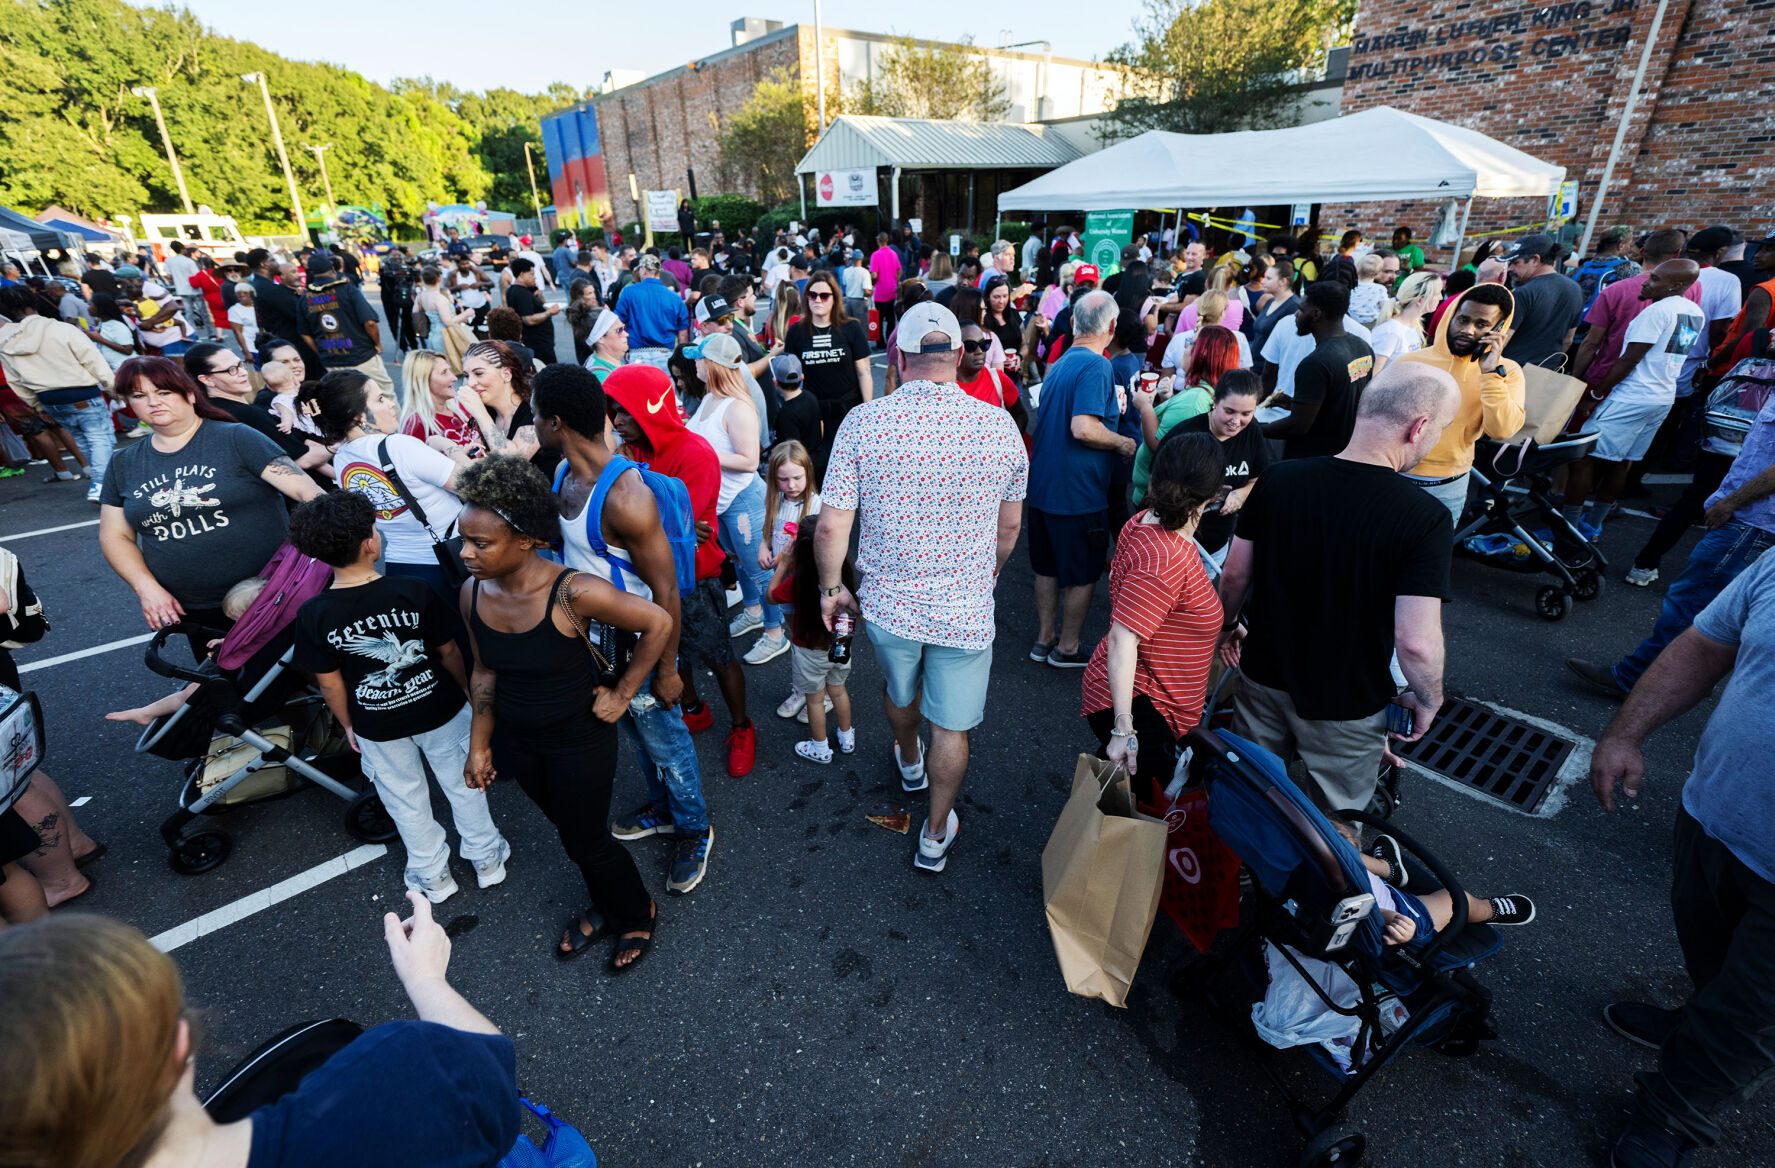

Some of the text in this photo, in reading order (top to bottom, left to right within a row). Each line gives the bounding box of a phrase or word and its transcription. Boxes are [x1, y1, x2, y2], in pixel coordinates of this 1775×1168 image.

[1354, 29, 1428, 54] MARTIN
[1436, 12, 1521, 42] LUTHER
[1532, 1, 1592, 26] KING
[1347, 26, 1631, 80] MULTIPURPOSE CENTER
[133, 465, 216, 499] STILL PLAYS
[142, 512, 168, 527] with
[153, 510, 230, 541] DOLLS
[327, 608, 420, 650] Serenity
[203, 786, 225, 802] PIVOT
